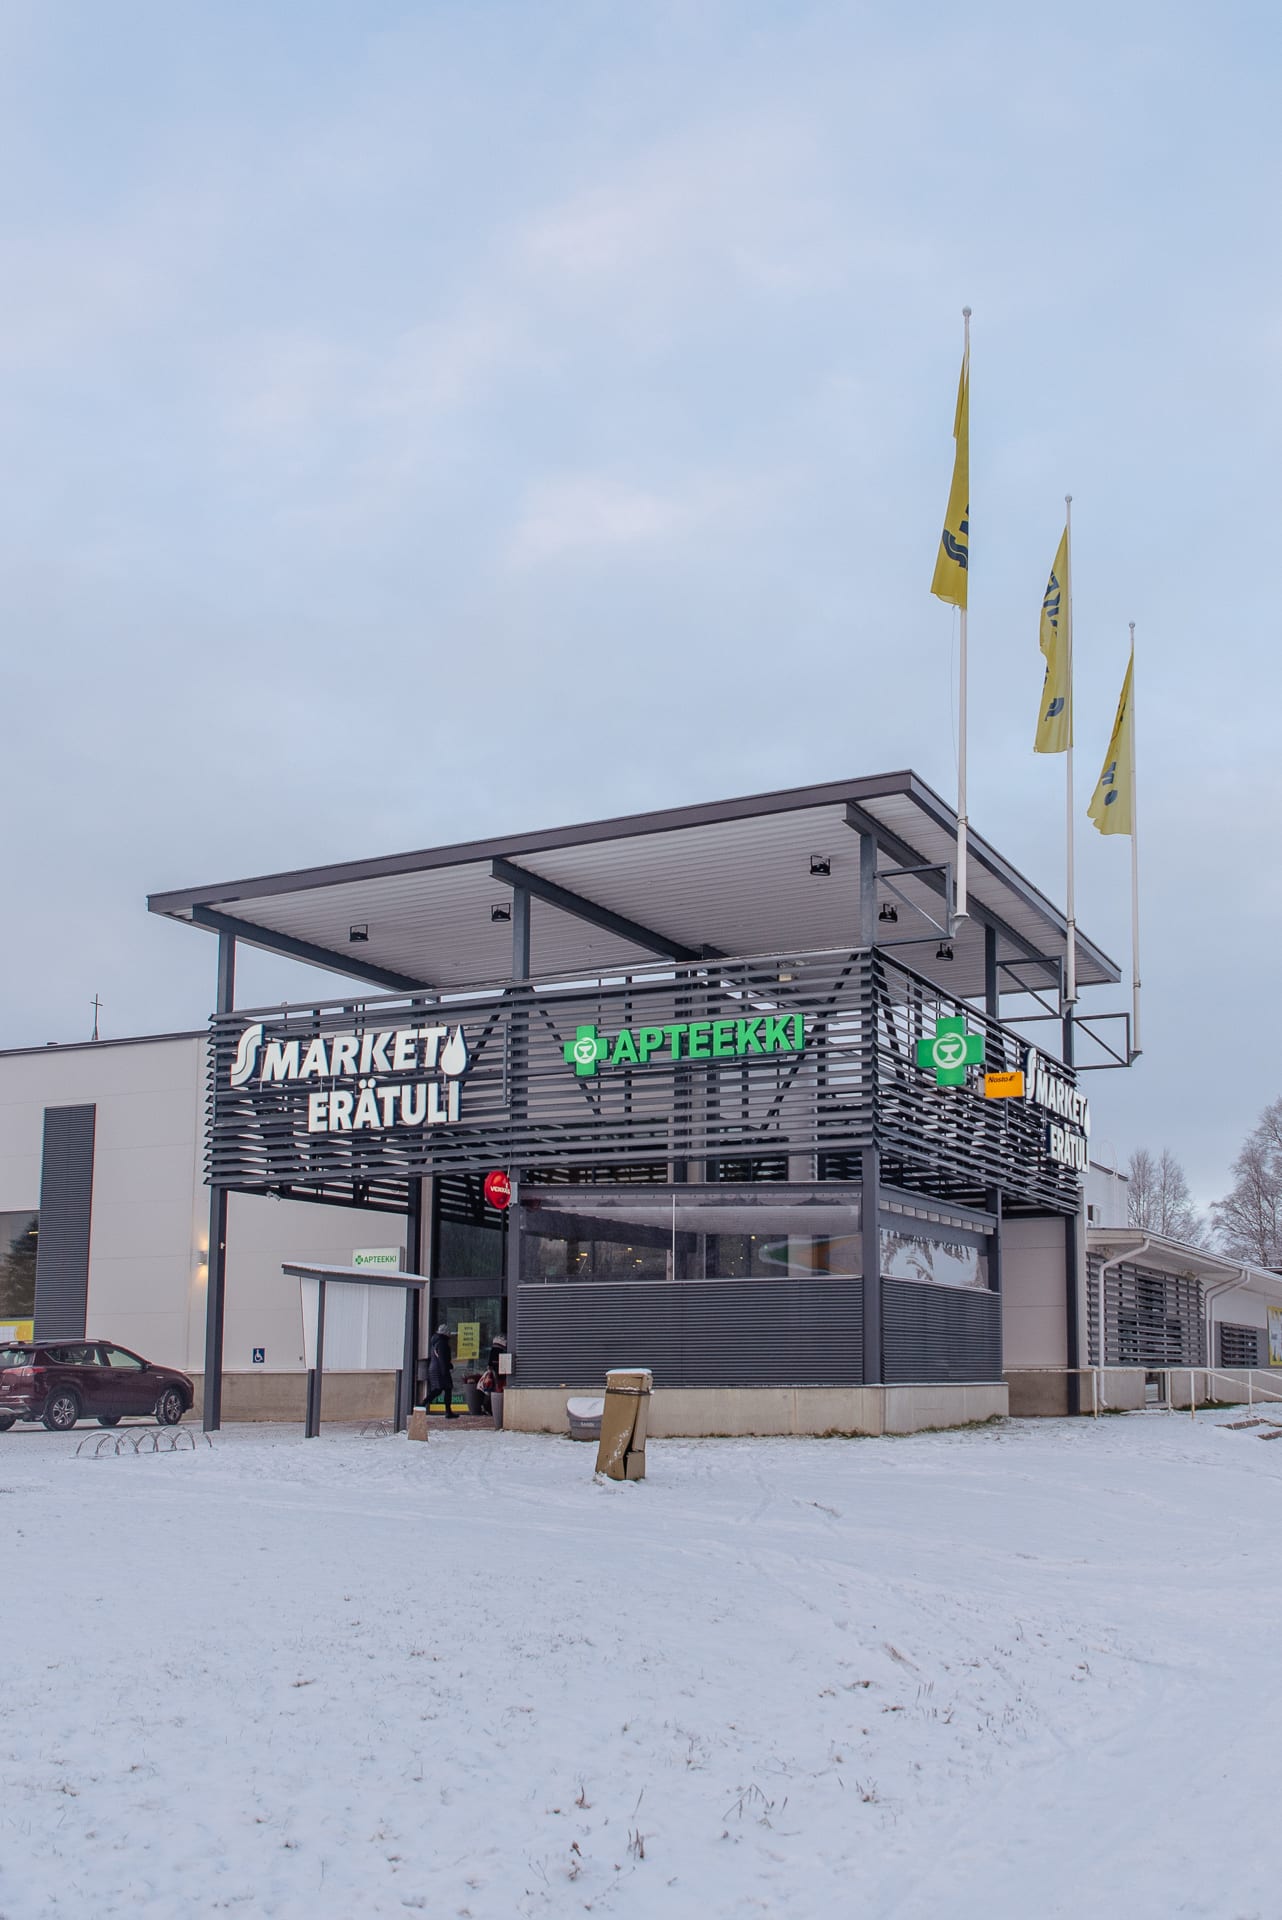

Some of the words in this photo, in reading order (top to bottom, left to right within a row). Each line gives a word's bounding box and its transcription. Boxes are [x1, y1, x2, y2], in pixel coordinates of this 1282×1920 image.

[611, 1013, 804, 1065] APTEEKKI
[308, 1078, 462, 1133] ERÄTULI
[1050, 1122, 1090, 1174] ERÄTULI
[363, 1255, 397, 1264] APTEEKKI
